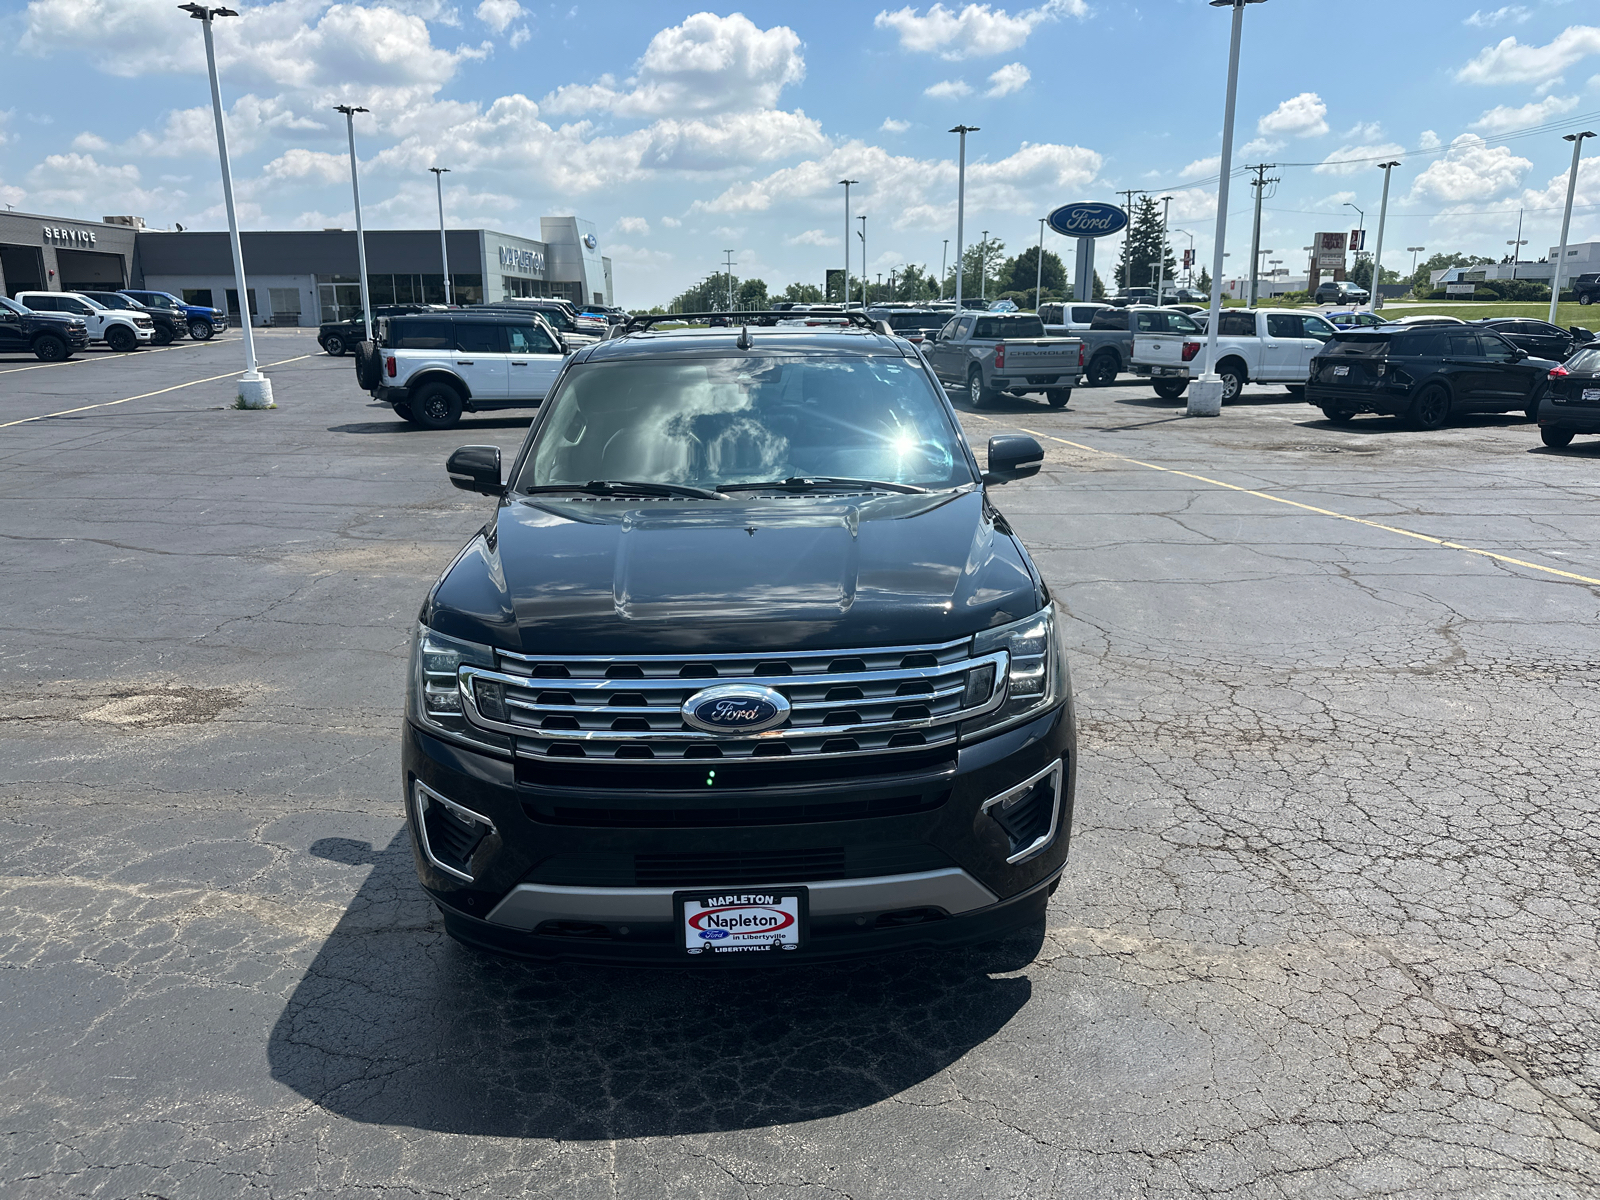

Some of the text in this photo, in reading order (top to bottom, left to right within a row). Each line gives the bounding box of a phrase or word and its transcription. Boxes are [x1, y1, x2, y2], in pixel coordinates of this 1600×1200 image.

[1066, 209, 1114, 229] Ford
[44, 226, 96, 243] SERVICE
[499, 245, 545, 270] NAPLETON
[711, 700, 759, 721] Ford
[707, 895, 774, 907] NAPLETON
[707, 914, 777, 930] Napleton
[715, 945, 771, 953] LIBERTYVILLE
